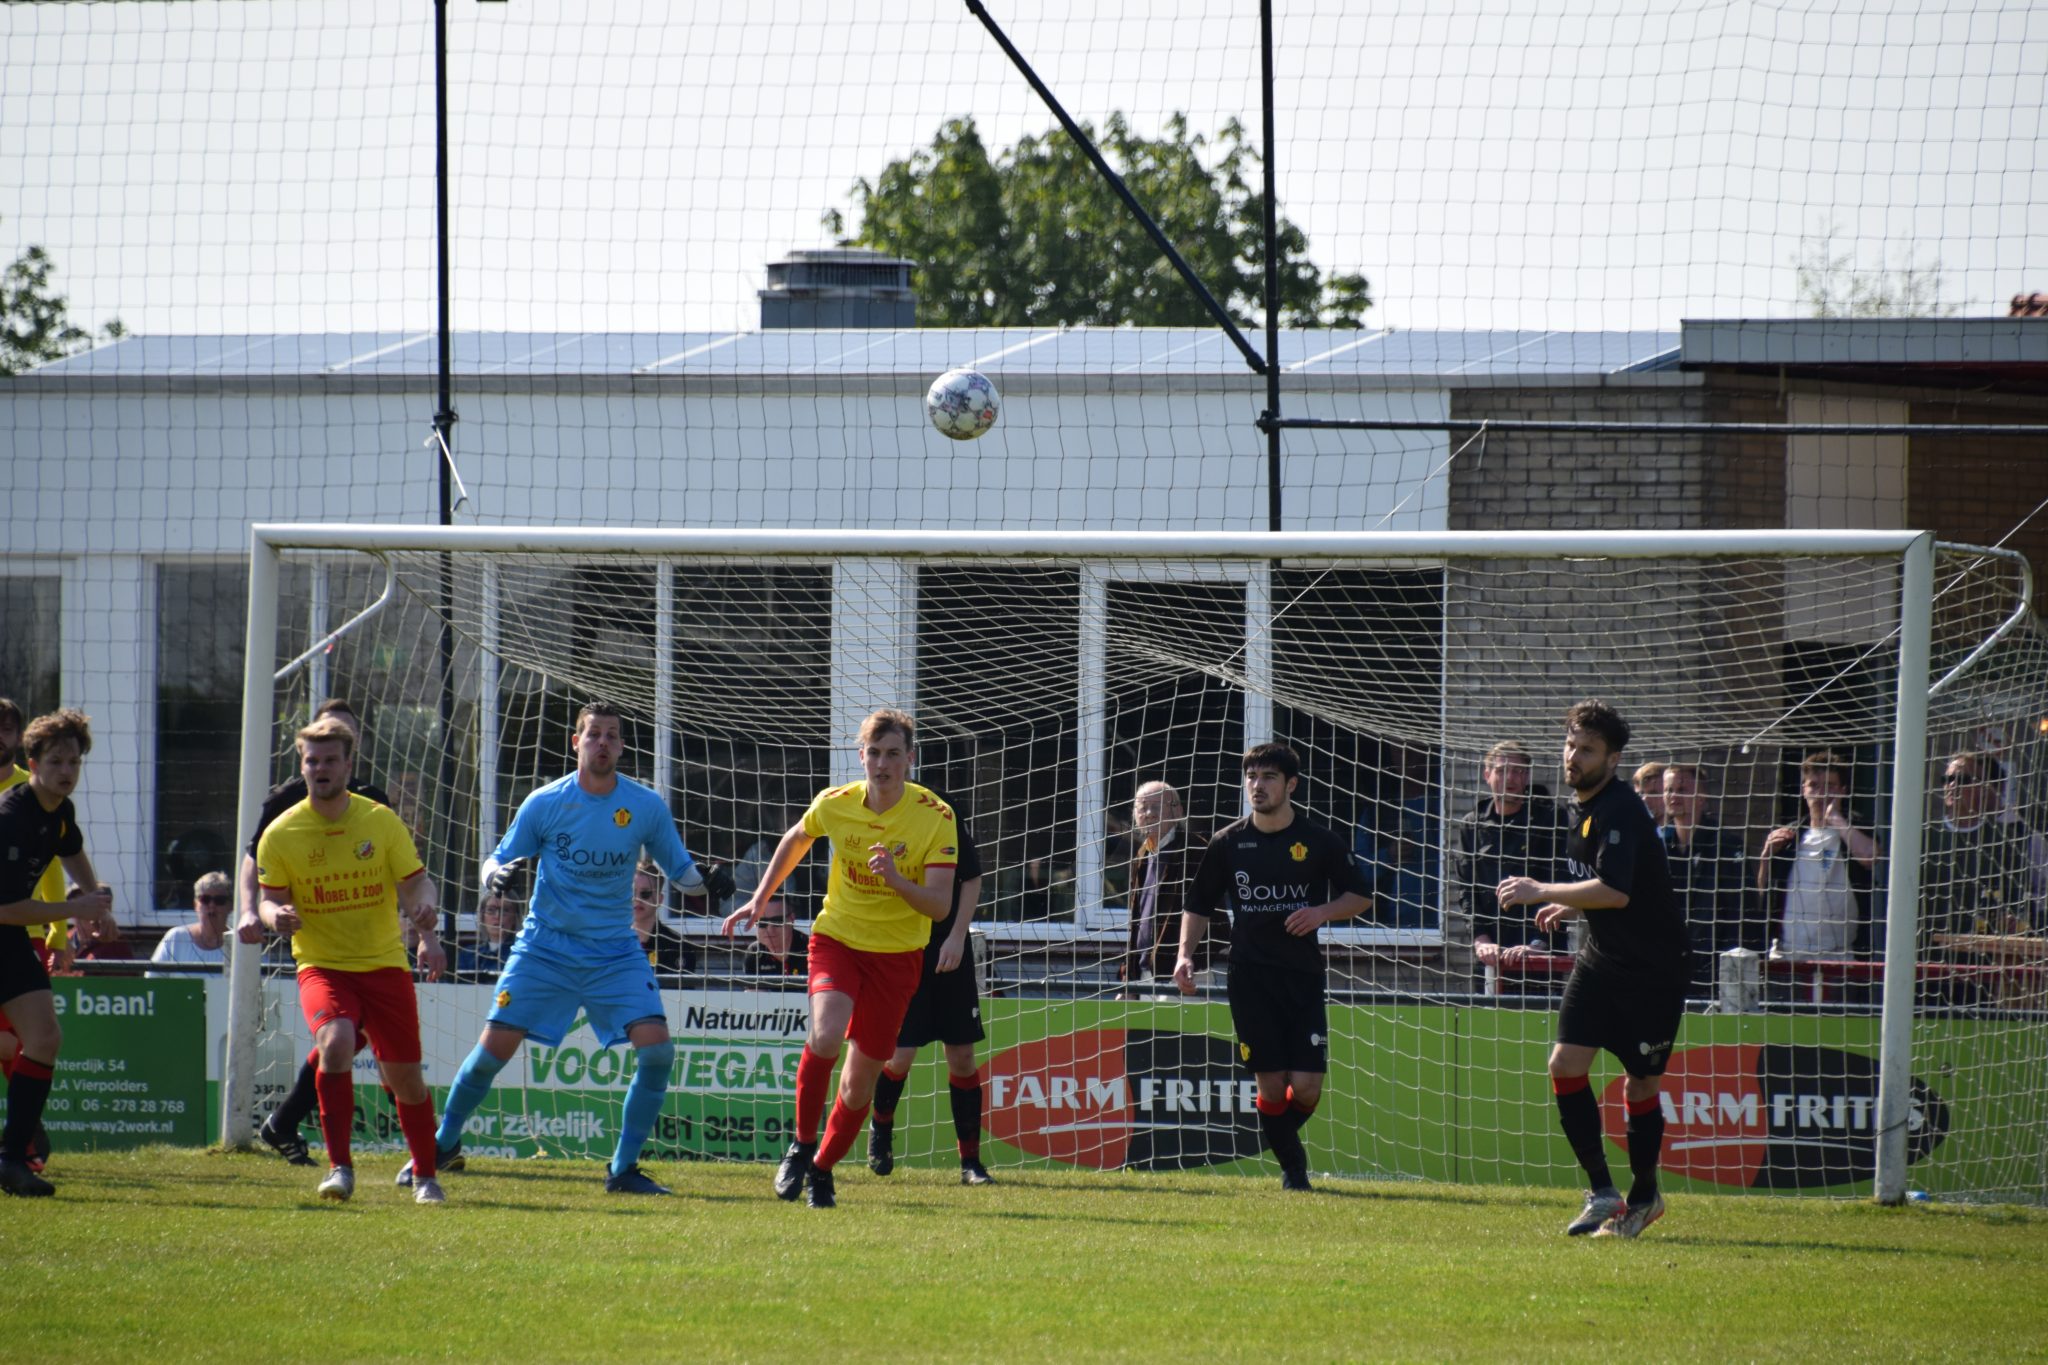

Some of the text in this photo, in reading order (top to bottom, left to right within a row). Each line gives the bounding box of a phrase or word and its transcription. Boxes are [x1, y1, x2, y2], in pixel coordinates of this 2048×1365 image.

[848, 865, 881, 887] NOBEL
[1568, 857, 1601, 880] OUW
[314, 884, 350, 904] NOBEL
[352, 887, 359, 900] &
[1235, 870, 1310, 900] BOUW
[1241, 901, 1309, 913] MANAGEMENT
[76, 988, 155, 1016] baan!
[55, 1059, 126, 1074] hterdijk 54
[73, 1079, 149, 1094] Vierpolders
[990, 1075, 1257, 1113] FARM FRITE
[81, 1099, 100, 1111] 06
[112, 1101, 136, 1113] 278
[140, 1101, 157, 1113] 28
[161, 1101, 185, 1114] 768
[1659, 1091, 1924, 1131] ARM FRITS
[43, 1119, 174, 1134] bureau-way2work.nl
[503, 1110, 605, 1143] zakelijk
[656, 1114, 796, 1143] 181 325 91
